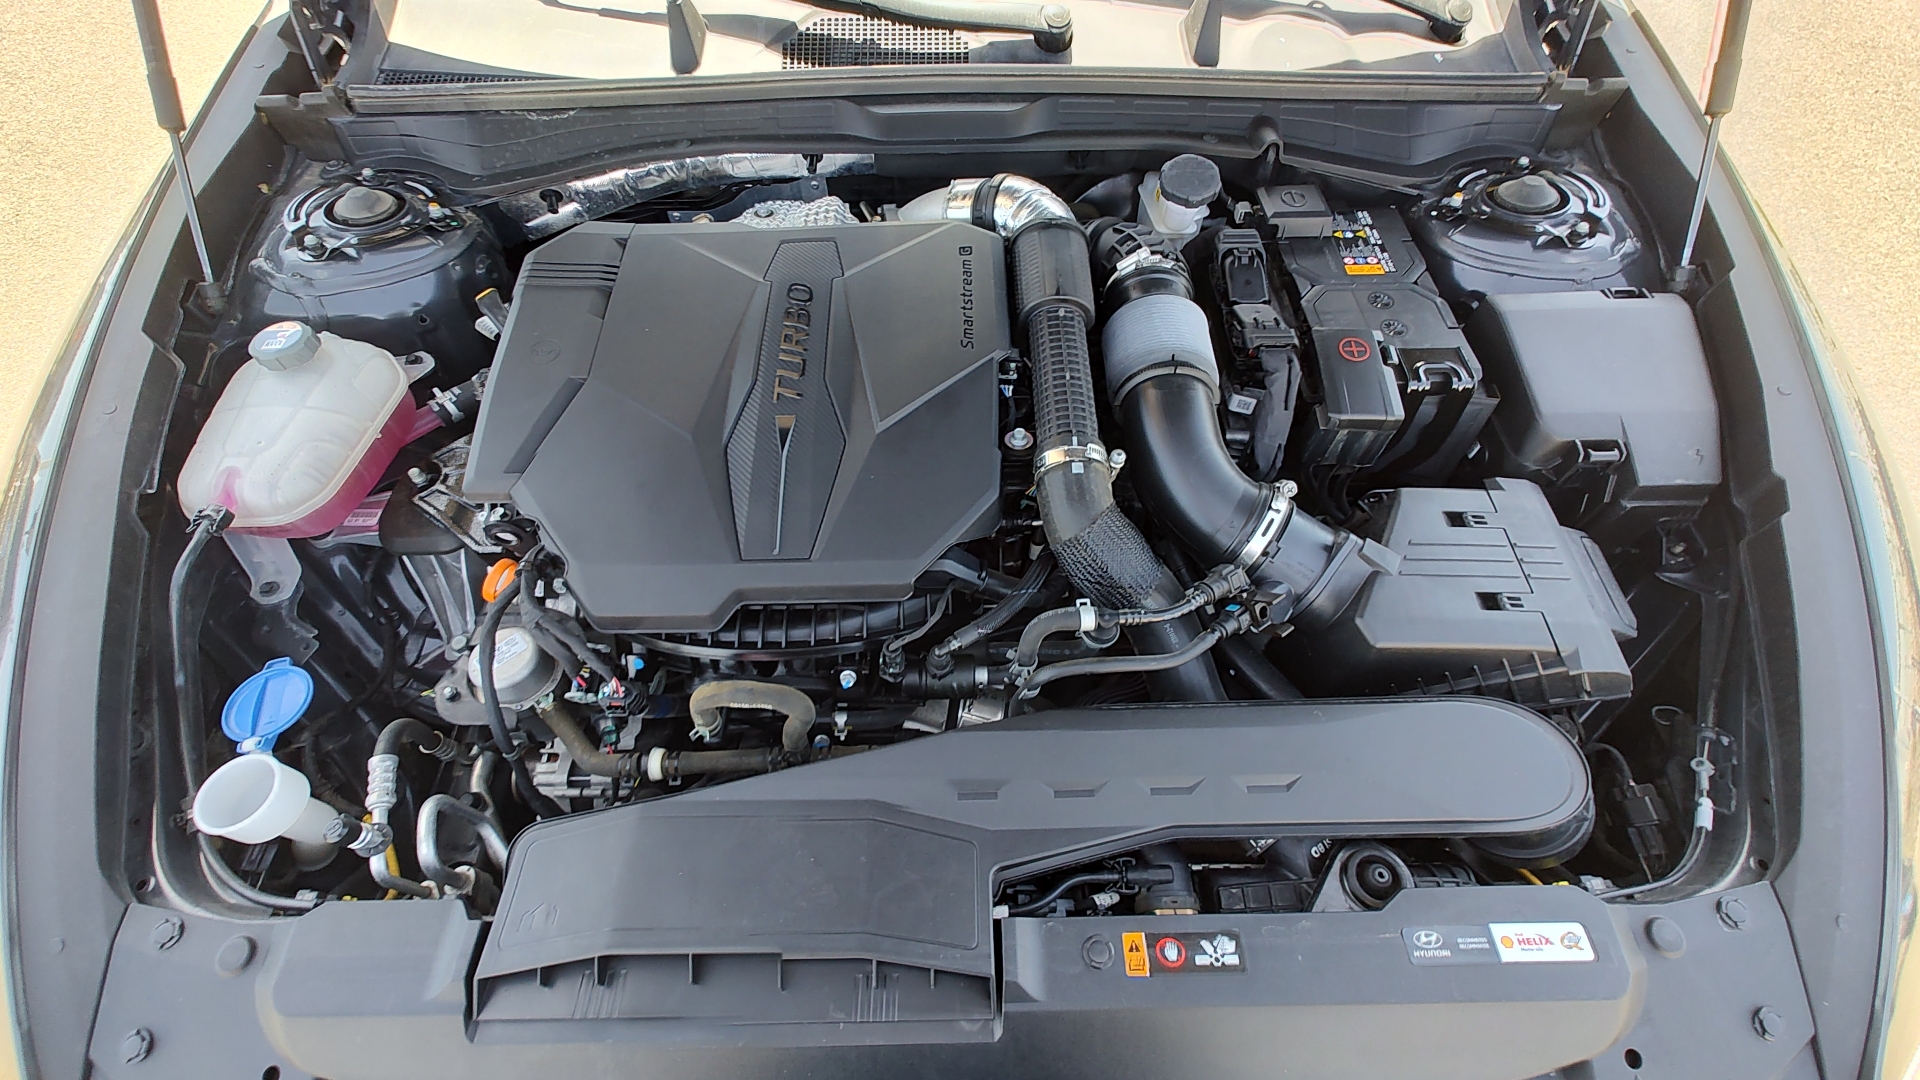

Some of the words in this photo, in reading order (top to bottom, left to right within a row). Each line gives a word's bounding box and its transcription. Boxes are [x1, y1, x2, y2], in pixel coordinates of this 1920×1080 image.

[959, 245, 973, 256] G
[960, 259, 975, 350] Smartstream
[773, 282, 814, 403] TURBO
[1516, 936, 1555, 946] HELIX
[1413, 949, 1451, 957] HYUNDAI
